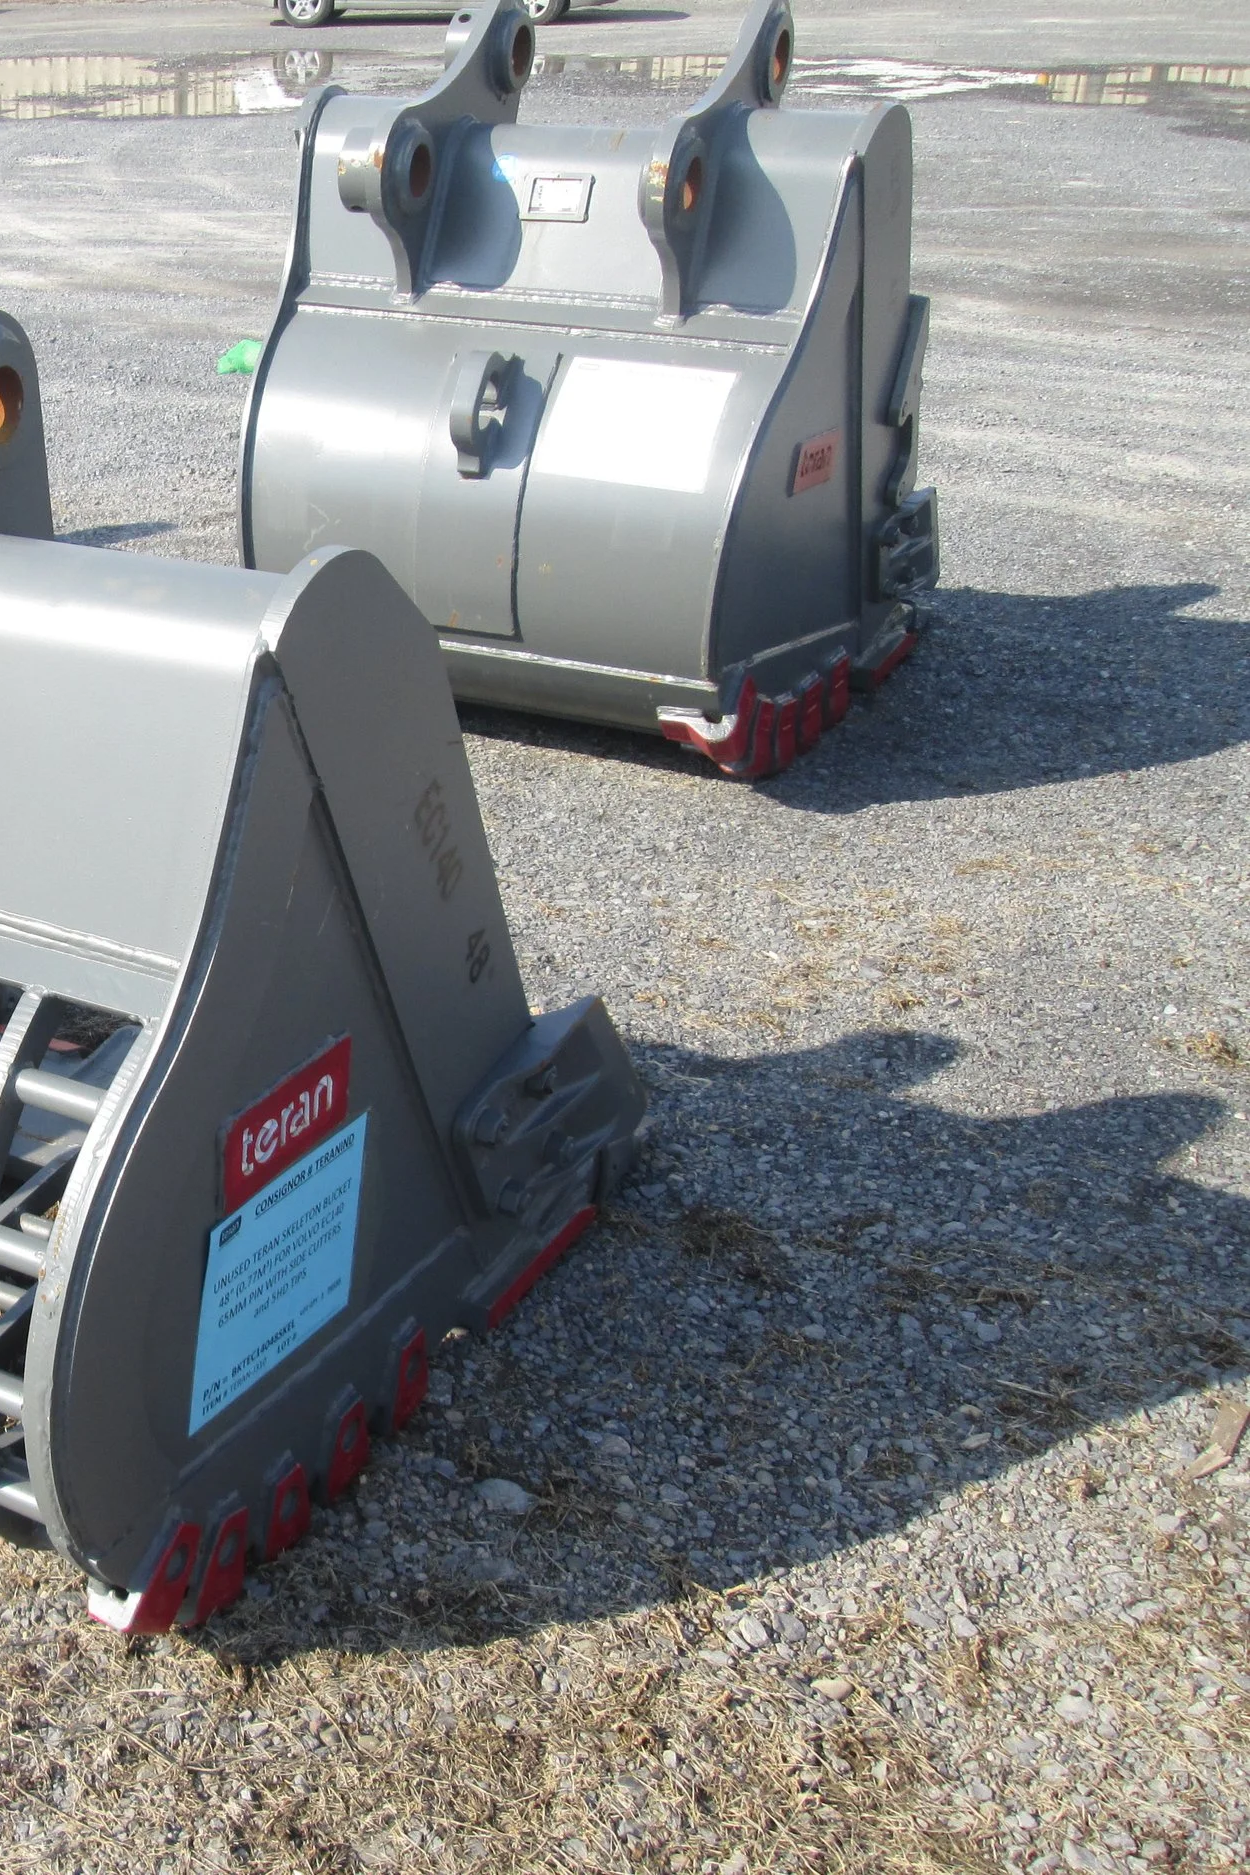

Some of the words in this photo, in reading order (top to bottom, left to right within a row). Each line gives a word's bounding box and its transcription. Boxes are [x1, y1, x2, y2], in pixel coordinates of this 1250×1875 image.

[241, 1074, 333, 1176] teran
[255, 1169, 306, 1216] CONSIGNOR
[213, 1257, 250, 1295] UNUSED
[253, 1234, 280, 1264] TERAN
[281, 1202, 322, 1242] SKELETON
[323, 1178, 351, 1209] BUCKET
[275, 1245, 291, 1266] FOR
[292, 1222, 320, 1252] VOLVO
[218, 1297, 247, 1329] 65MM
[249, 1284, 263, 1304] PIN
[265, 1266, 287, 1291] WITH
[289, 1251, 306, 1272] SIDE
[308, 1220, 342, 1257] CUTTERS
[254, 1298, 269, 1318] and
[291, 1267, 307, 1288] TIPS
[202, 1379, 221, 1401] P/N
